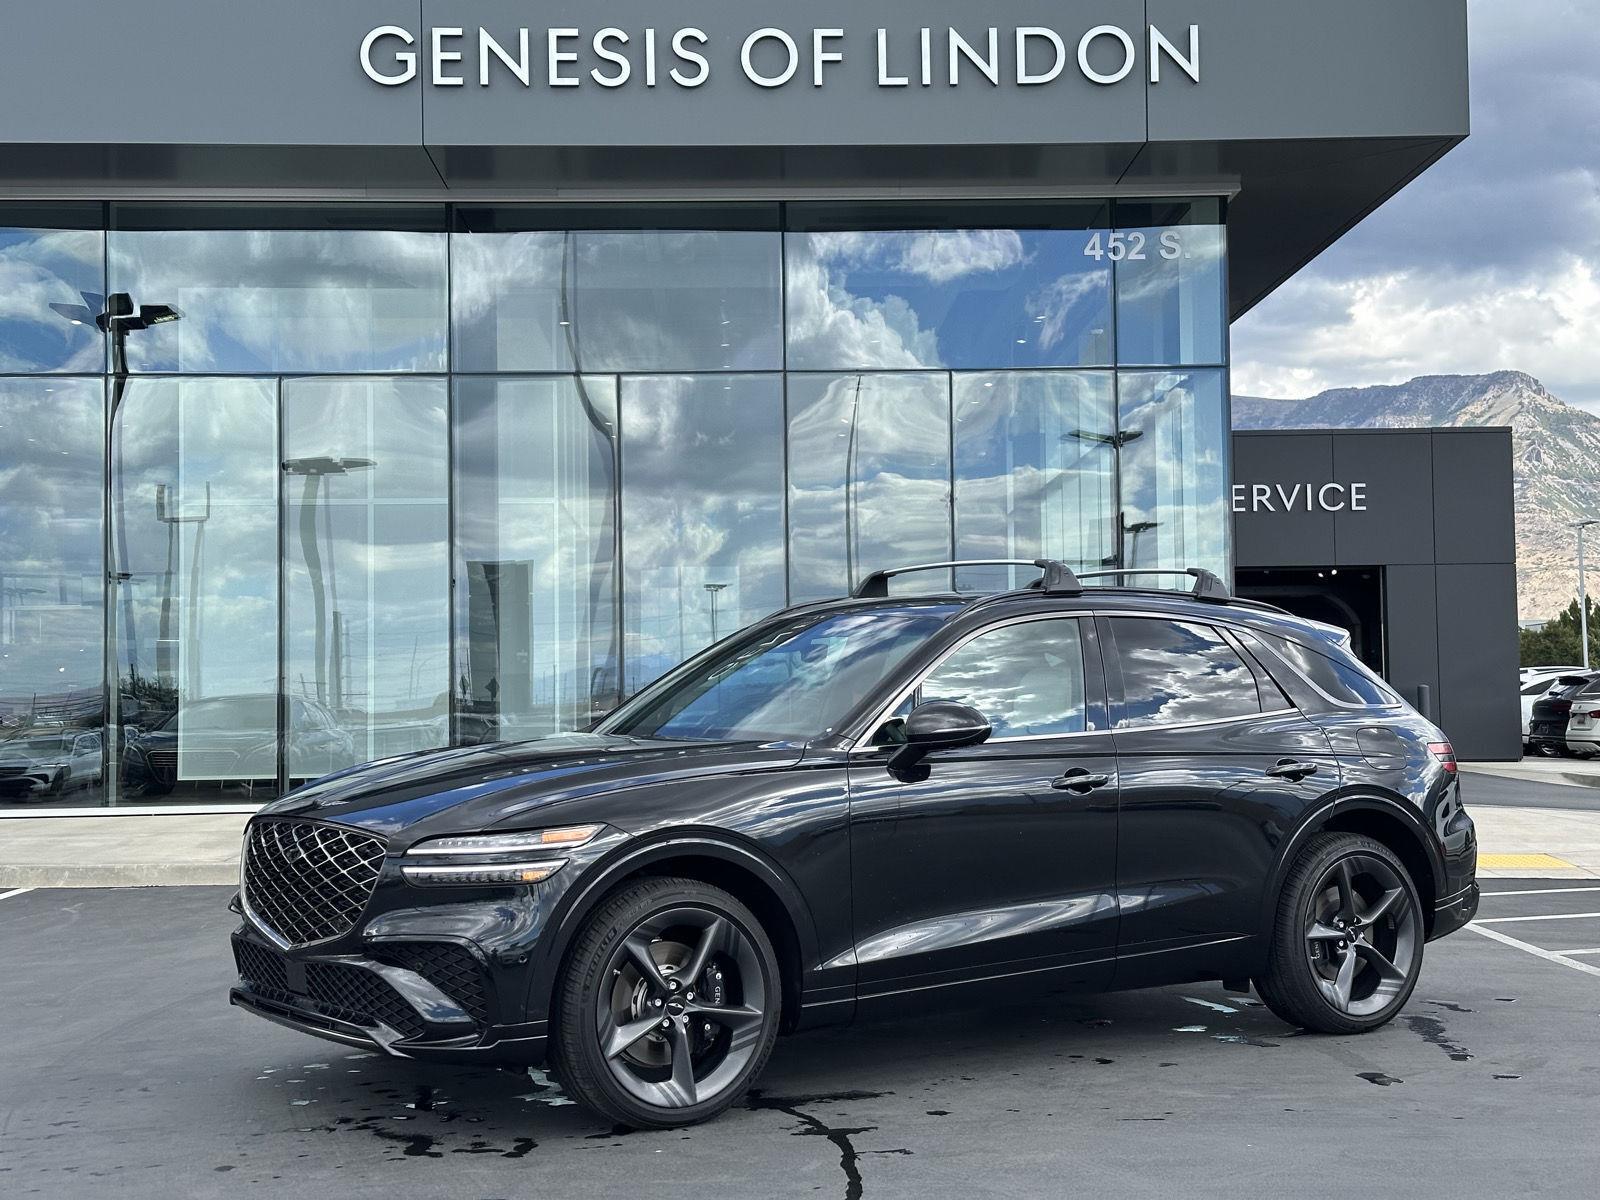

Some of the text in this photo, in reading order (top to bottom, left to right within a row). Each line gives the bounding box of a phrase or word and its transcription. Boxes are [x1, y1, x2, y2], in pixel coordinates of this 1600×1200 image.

[359, 24, 1200, 88] GENESIS OF LINDON
[1083, 230, 1192, 261] 452 S.
[1231, 482, 1367, 512] ERVICE
